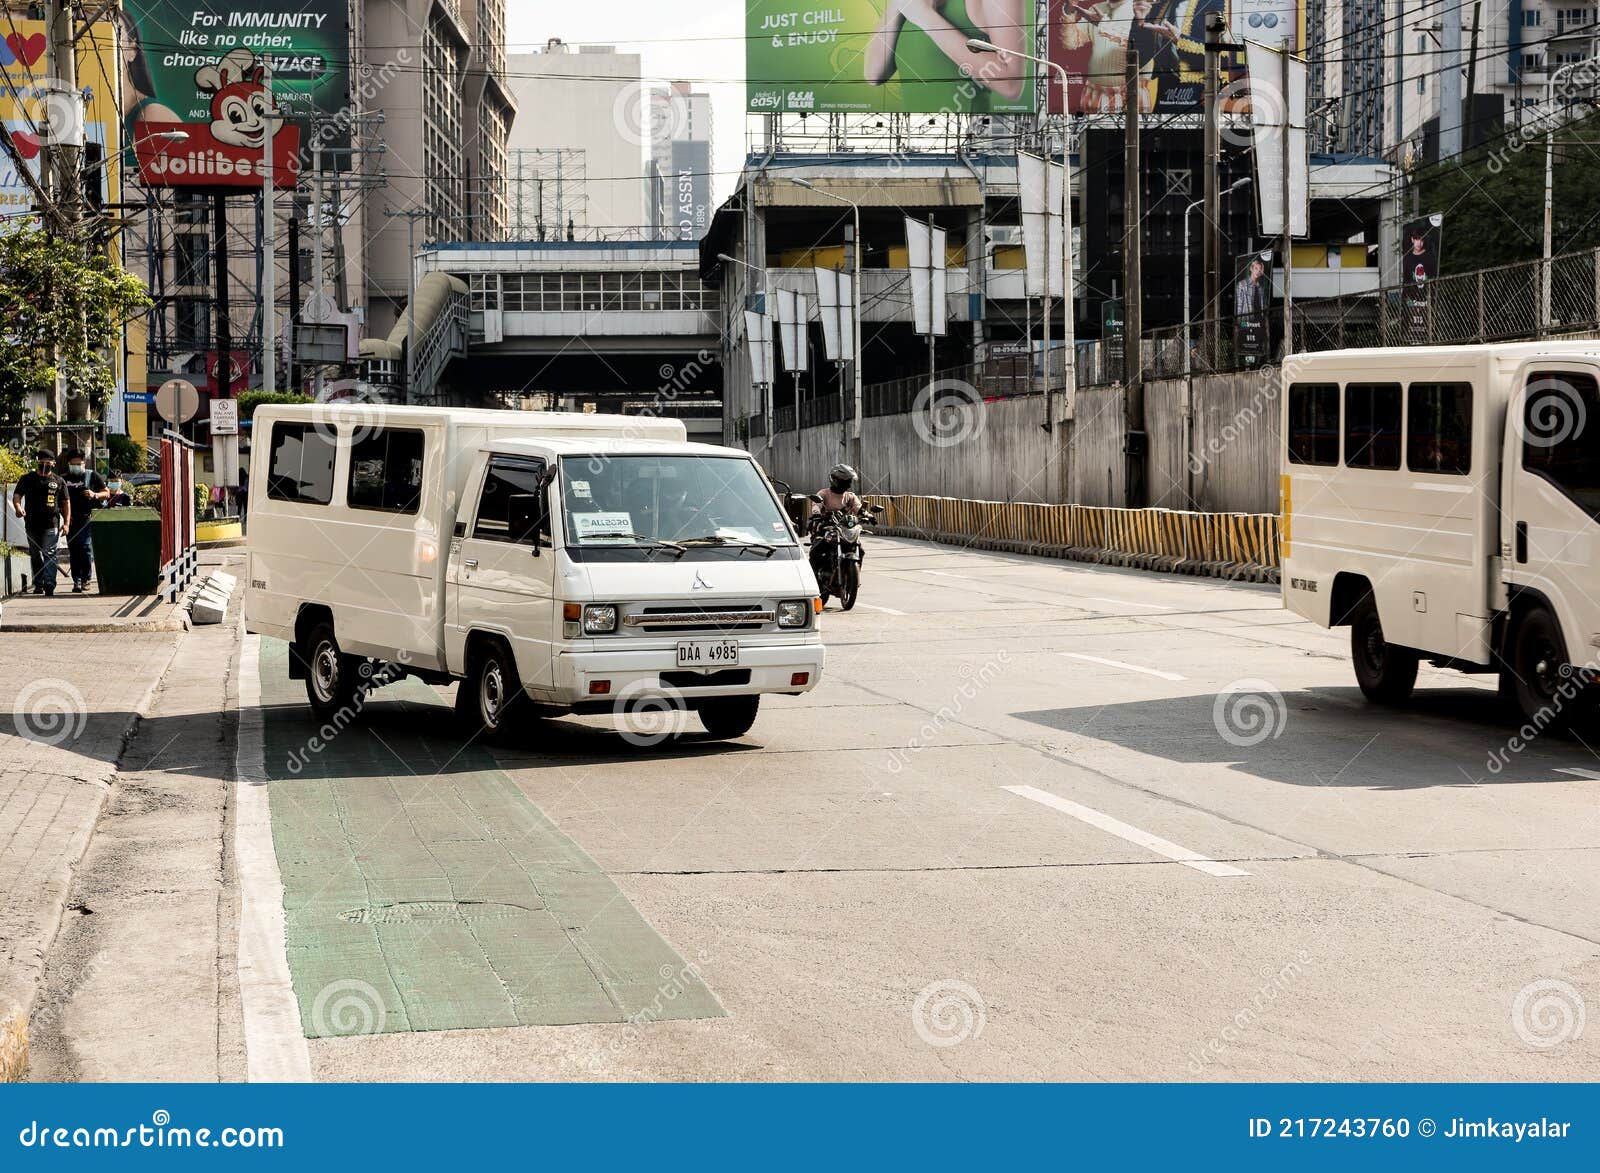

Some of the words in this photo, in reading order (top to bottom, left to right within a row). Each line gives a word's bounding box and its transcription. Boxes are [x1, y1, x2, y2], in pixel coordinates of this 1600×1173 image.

[191, 11, 223, 27] For
[227, 12, 327, 28] IMMUNITY
[760, 13, 798, 29] JUST
[803, 8, 845, 25] CHILL
[179, 30, 209, 45] like
[214, 34, 237, 46] no
[242, 31, 293, 48] other,
[771, 34, 784, 48] &
[788, 28, 839, 47] ENJOY
[750, 95, 782, 108] easy
[679, 166, 693, 216] ASSN.
[695, 204, 705, 228] 1890
[680, 646, 701, 661] DAA
[709, 646, 737, 660] 4985
